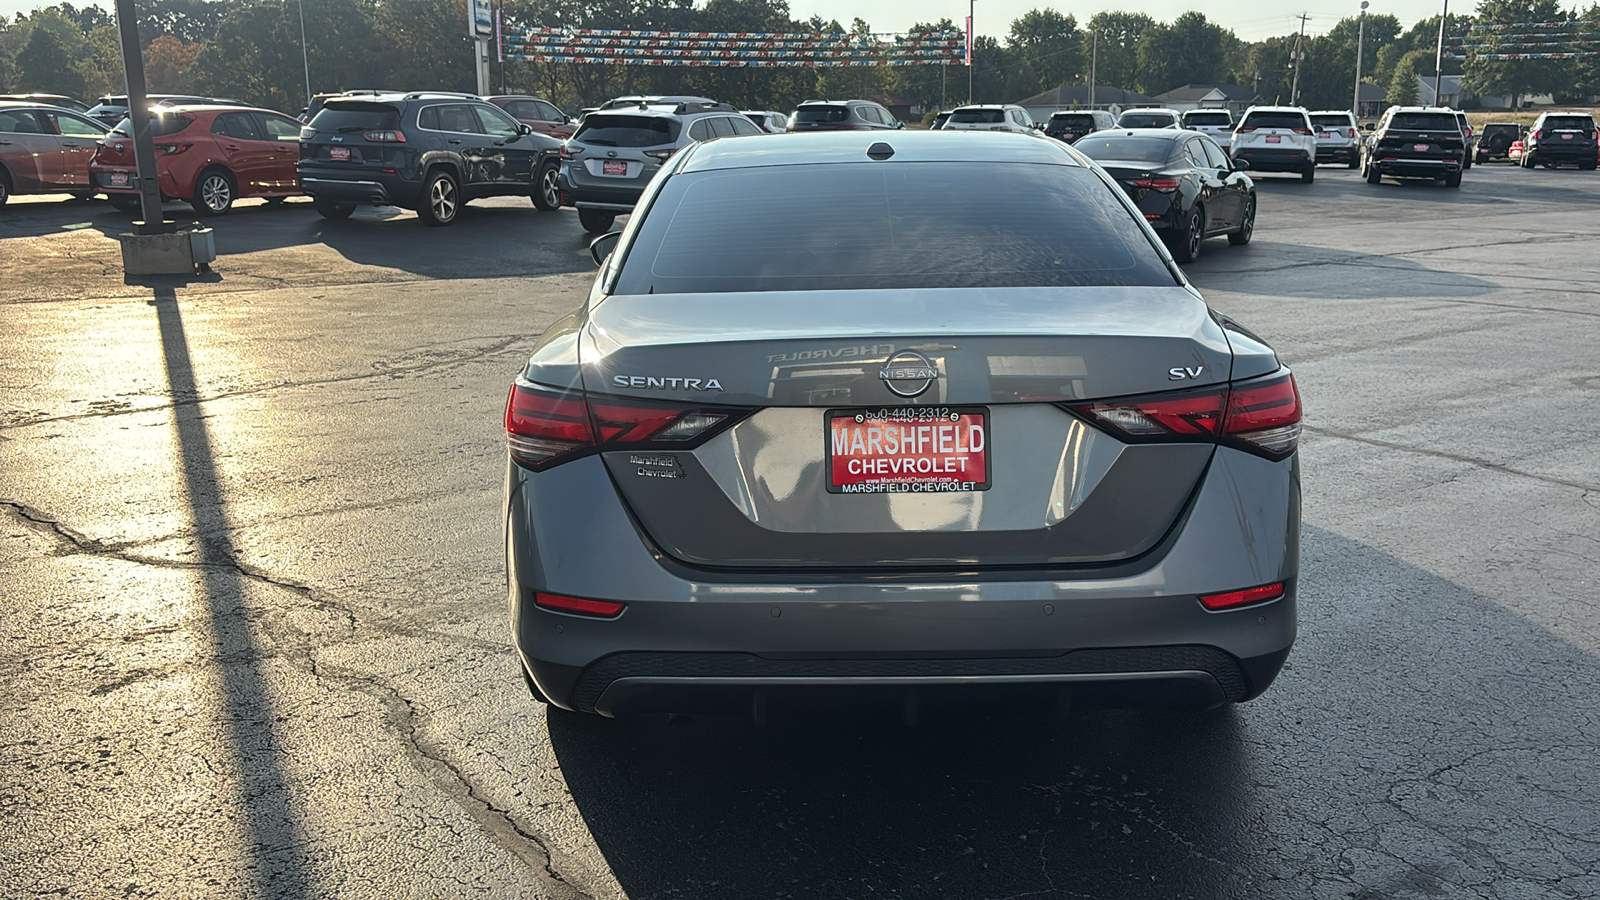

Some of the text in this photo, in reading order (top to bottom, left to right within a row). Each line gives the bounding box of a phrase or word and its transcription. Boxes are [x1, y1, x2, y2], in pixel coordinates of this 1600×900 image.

[879, 369, 937, 379] NISSAN
[1168, 366, 1203, 380] SV
[613, 375, 724, 391] SENTRA
[831, 424, 985, 456] MARSHFIELD
[630, 455, 673, 466] Marshfield
[848, 456, 969, 475] CHEVROLET
[637, 467, 676, 478] Chevrolet
[866, 476, 952, 484] www.MarshfieldChevrolet.com
[842, 481, 976, 493] MARSHFIELD CHEVROLET
